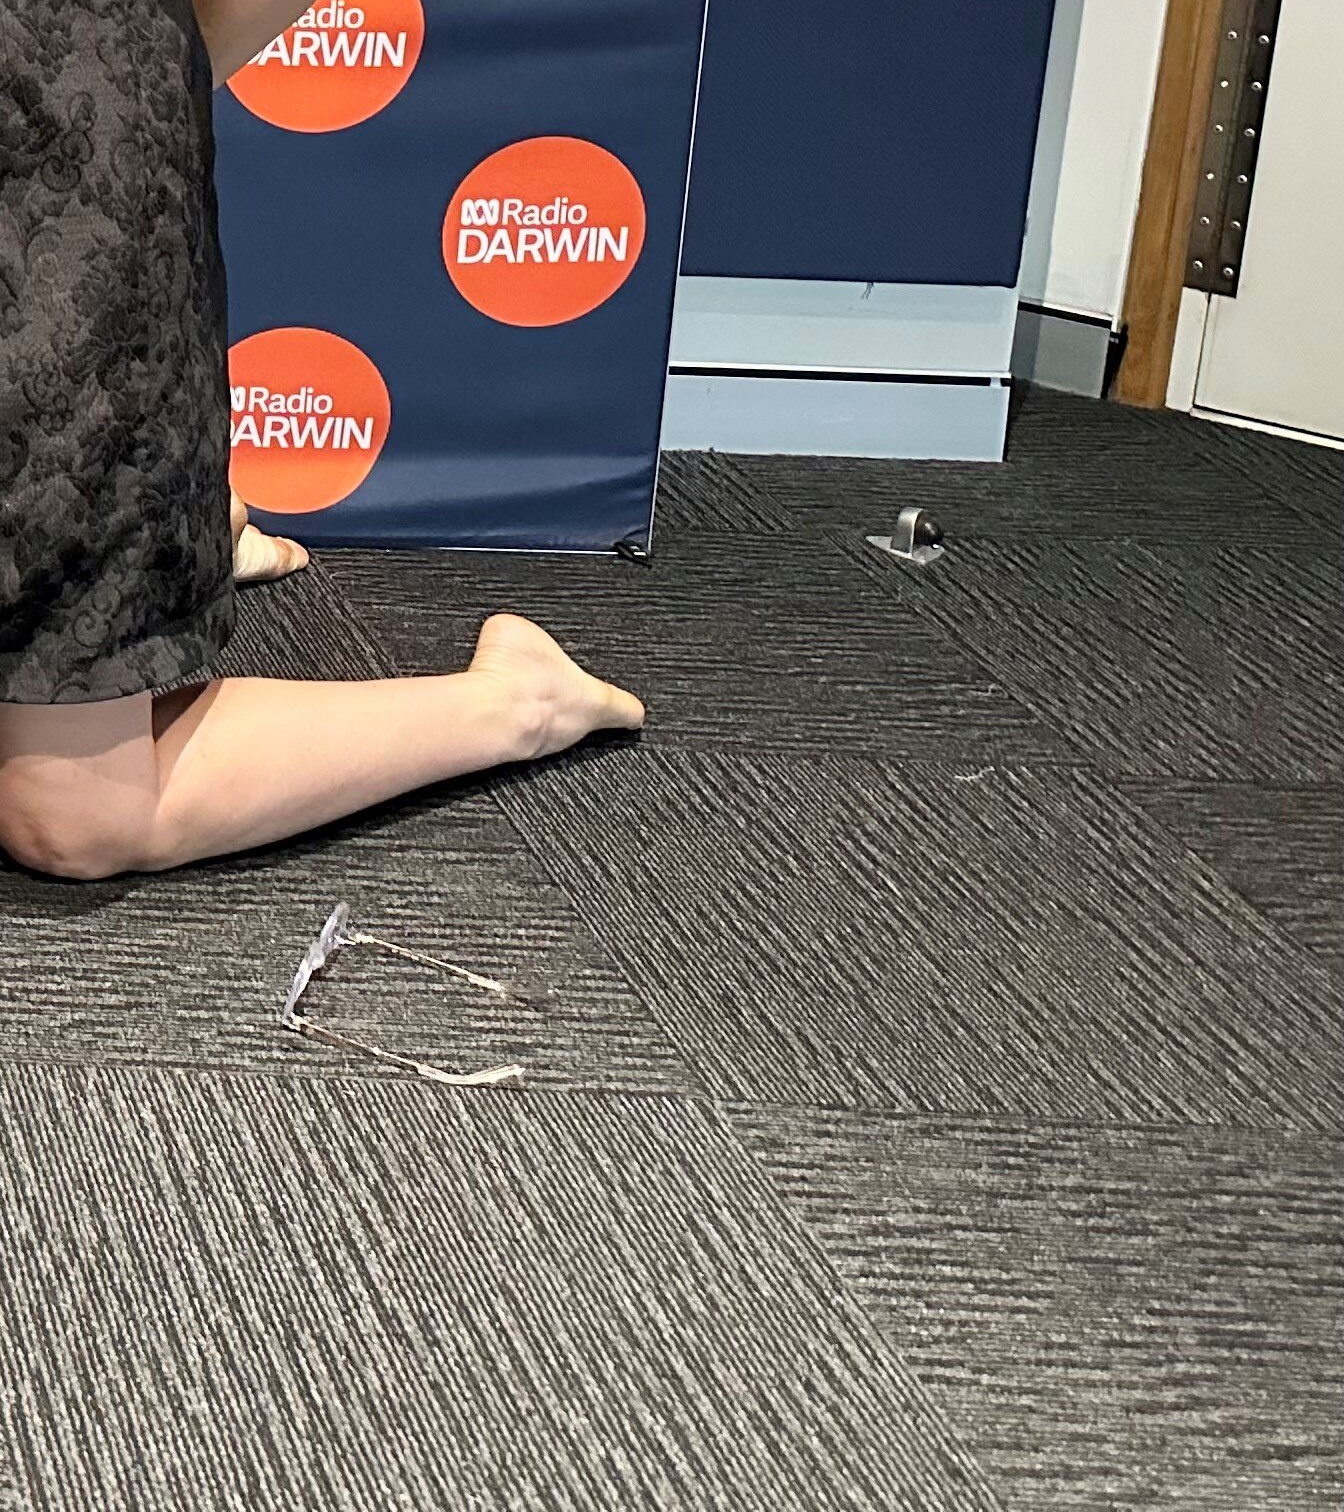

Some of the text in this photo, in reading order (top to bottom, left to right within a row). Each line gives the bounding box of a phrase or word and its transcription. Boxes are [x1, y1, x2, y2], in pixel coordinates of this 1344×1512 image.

[291, 0, 366, 29] adio
[246, 31, 407, 68] ARWIN
[500, 196, 588, 227] Radio
[457, 225, 629, 264] DARWIN
[247, 386, 334, 415] Radio
[229, 414, 375, 450] ARWIN
